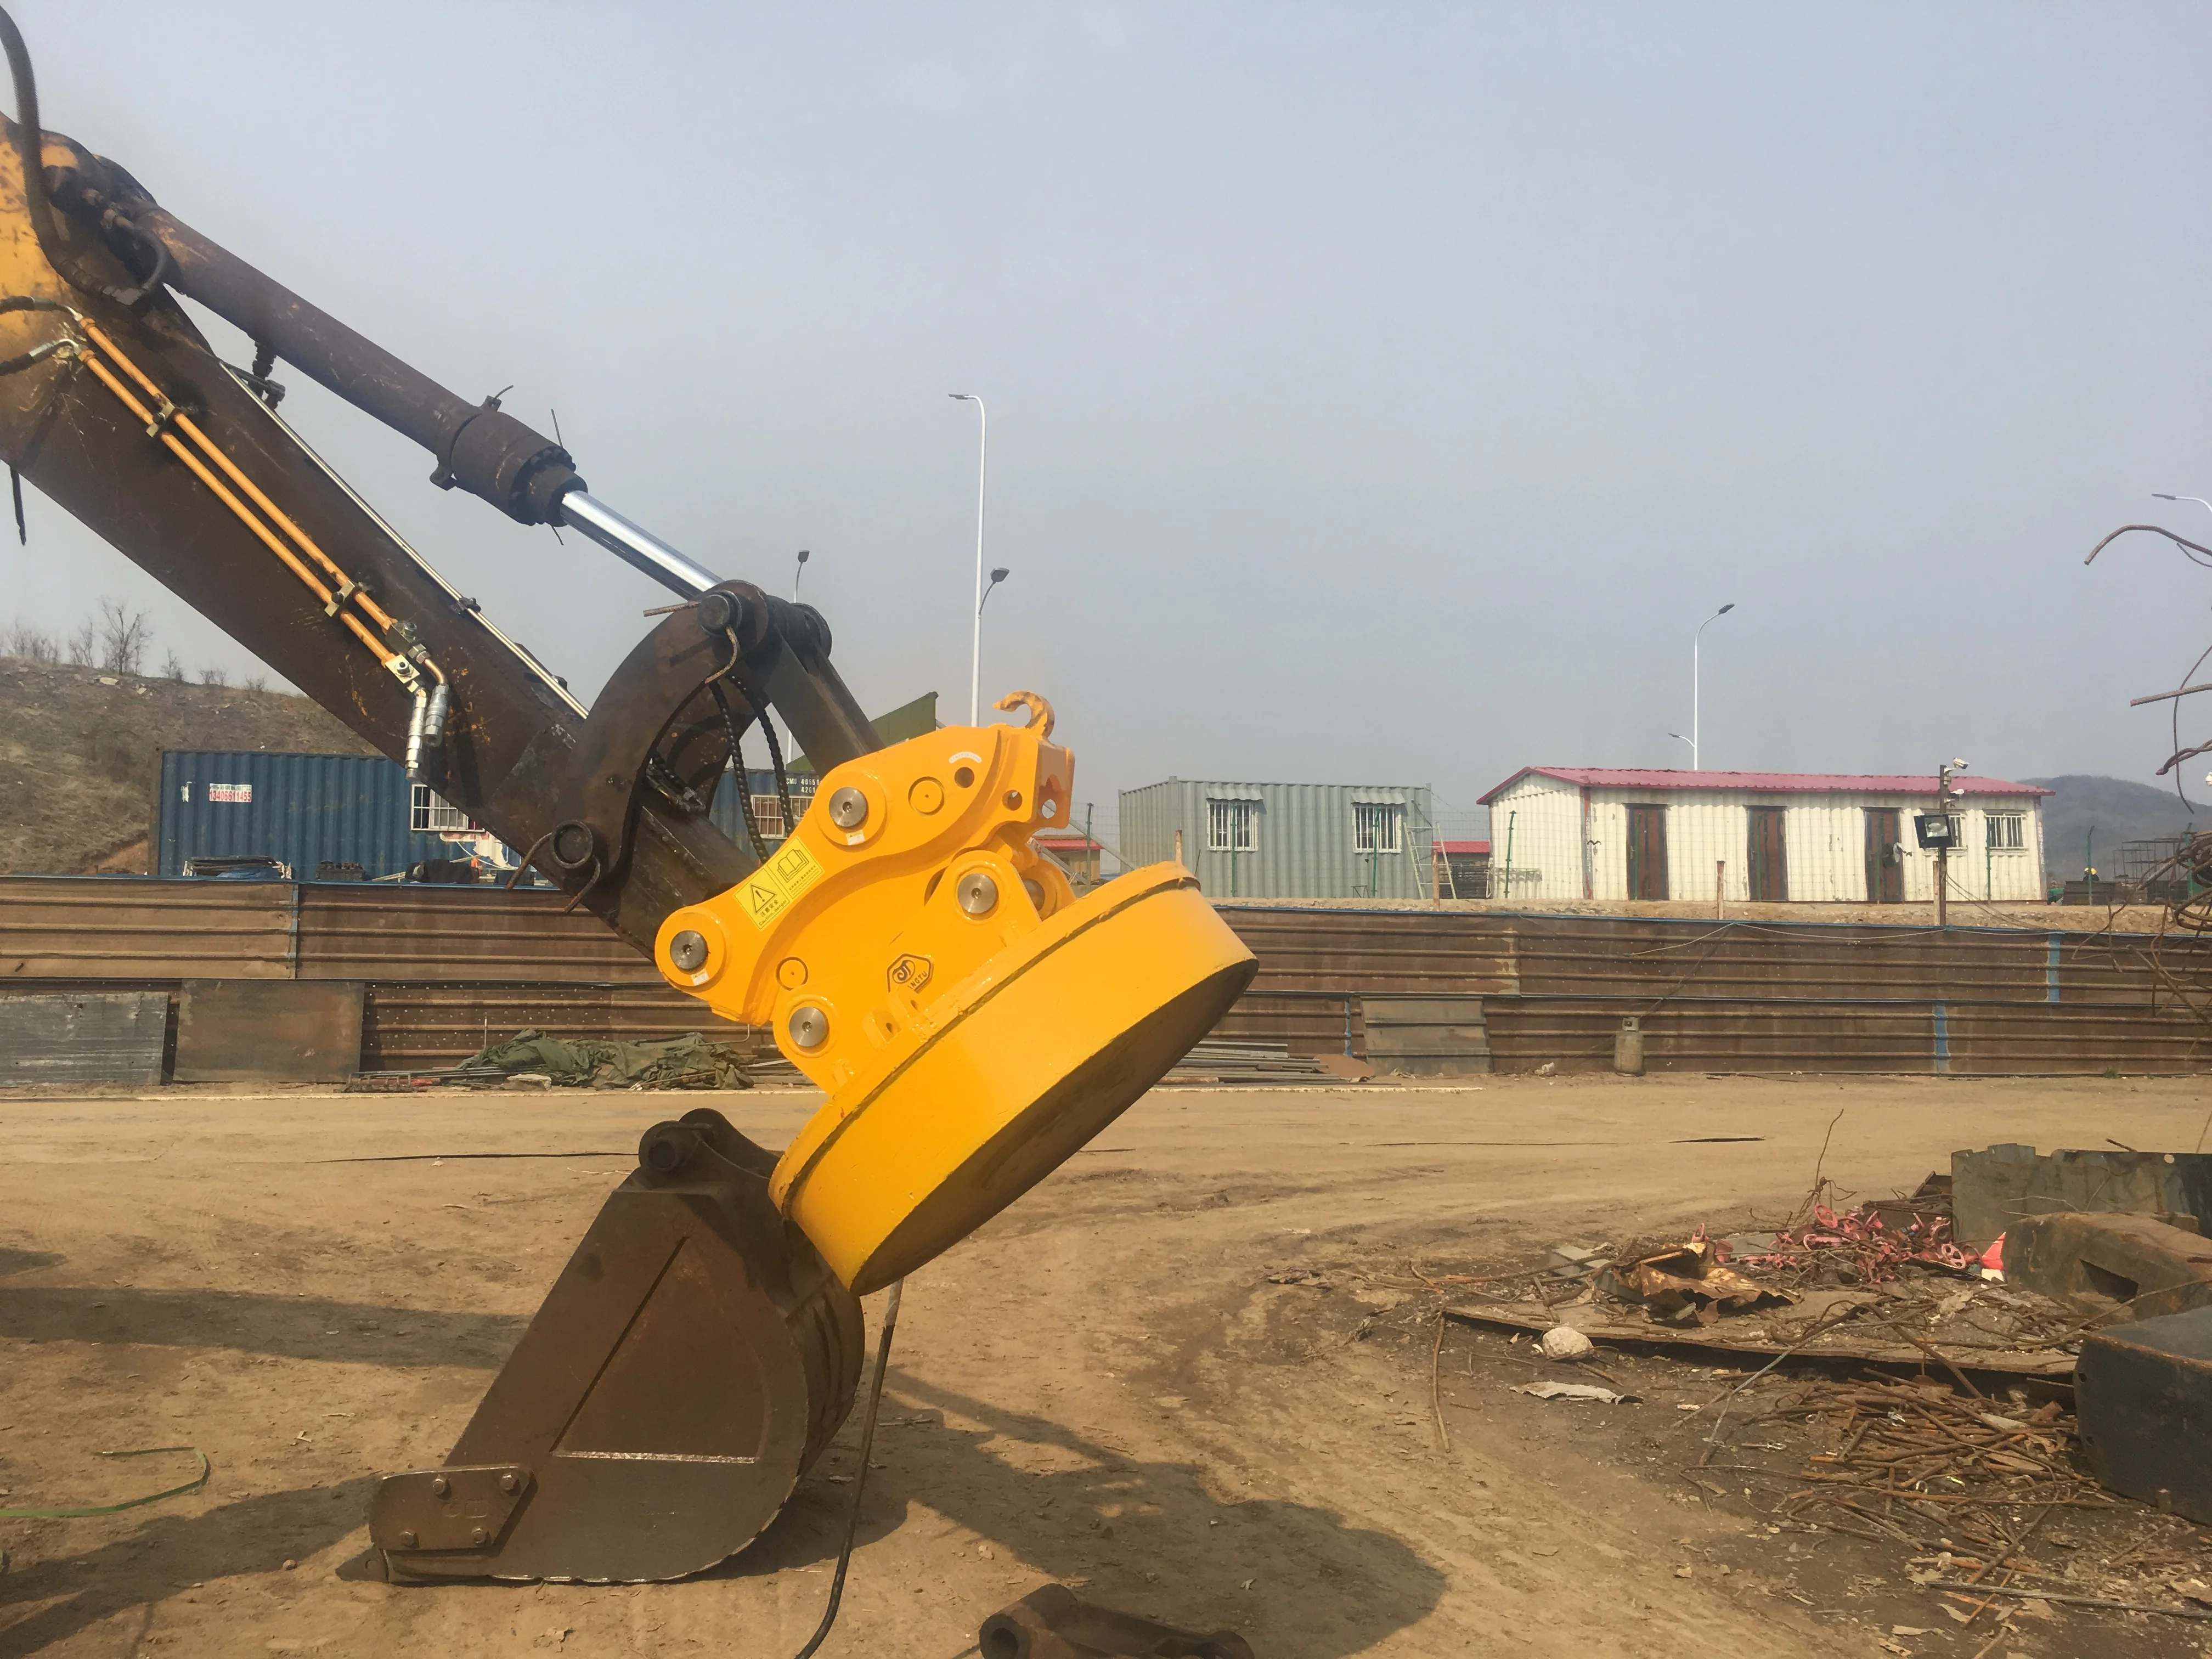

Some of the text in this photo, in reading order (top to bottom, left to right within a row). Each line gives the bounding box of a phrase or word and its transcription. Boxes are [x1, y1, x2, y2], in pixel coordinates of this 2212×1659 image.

[209, 790, 251, 802] 13406611455
[760, 899, 779, 917] 注意安全
